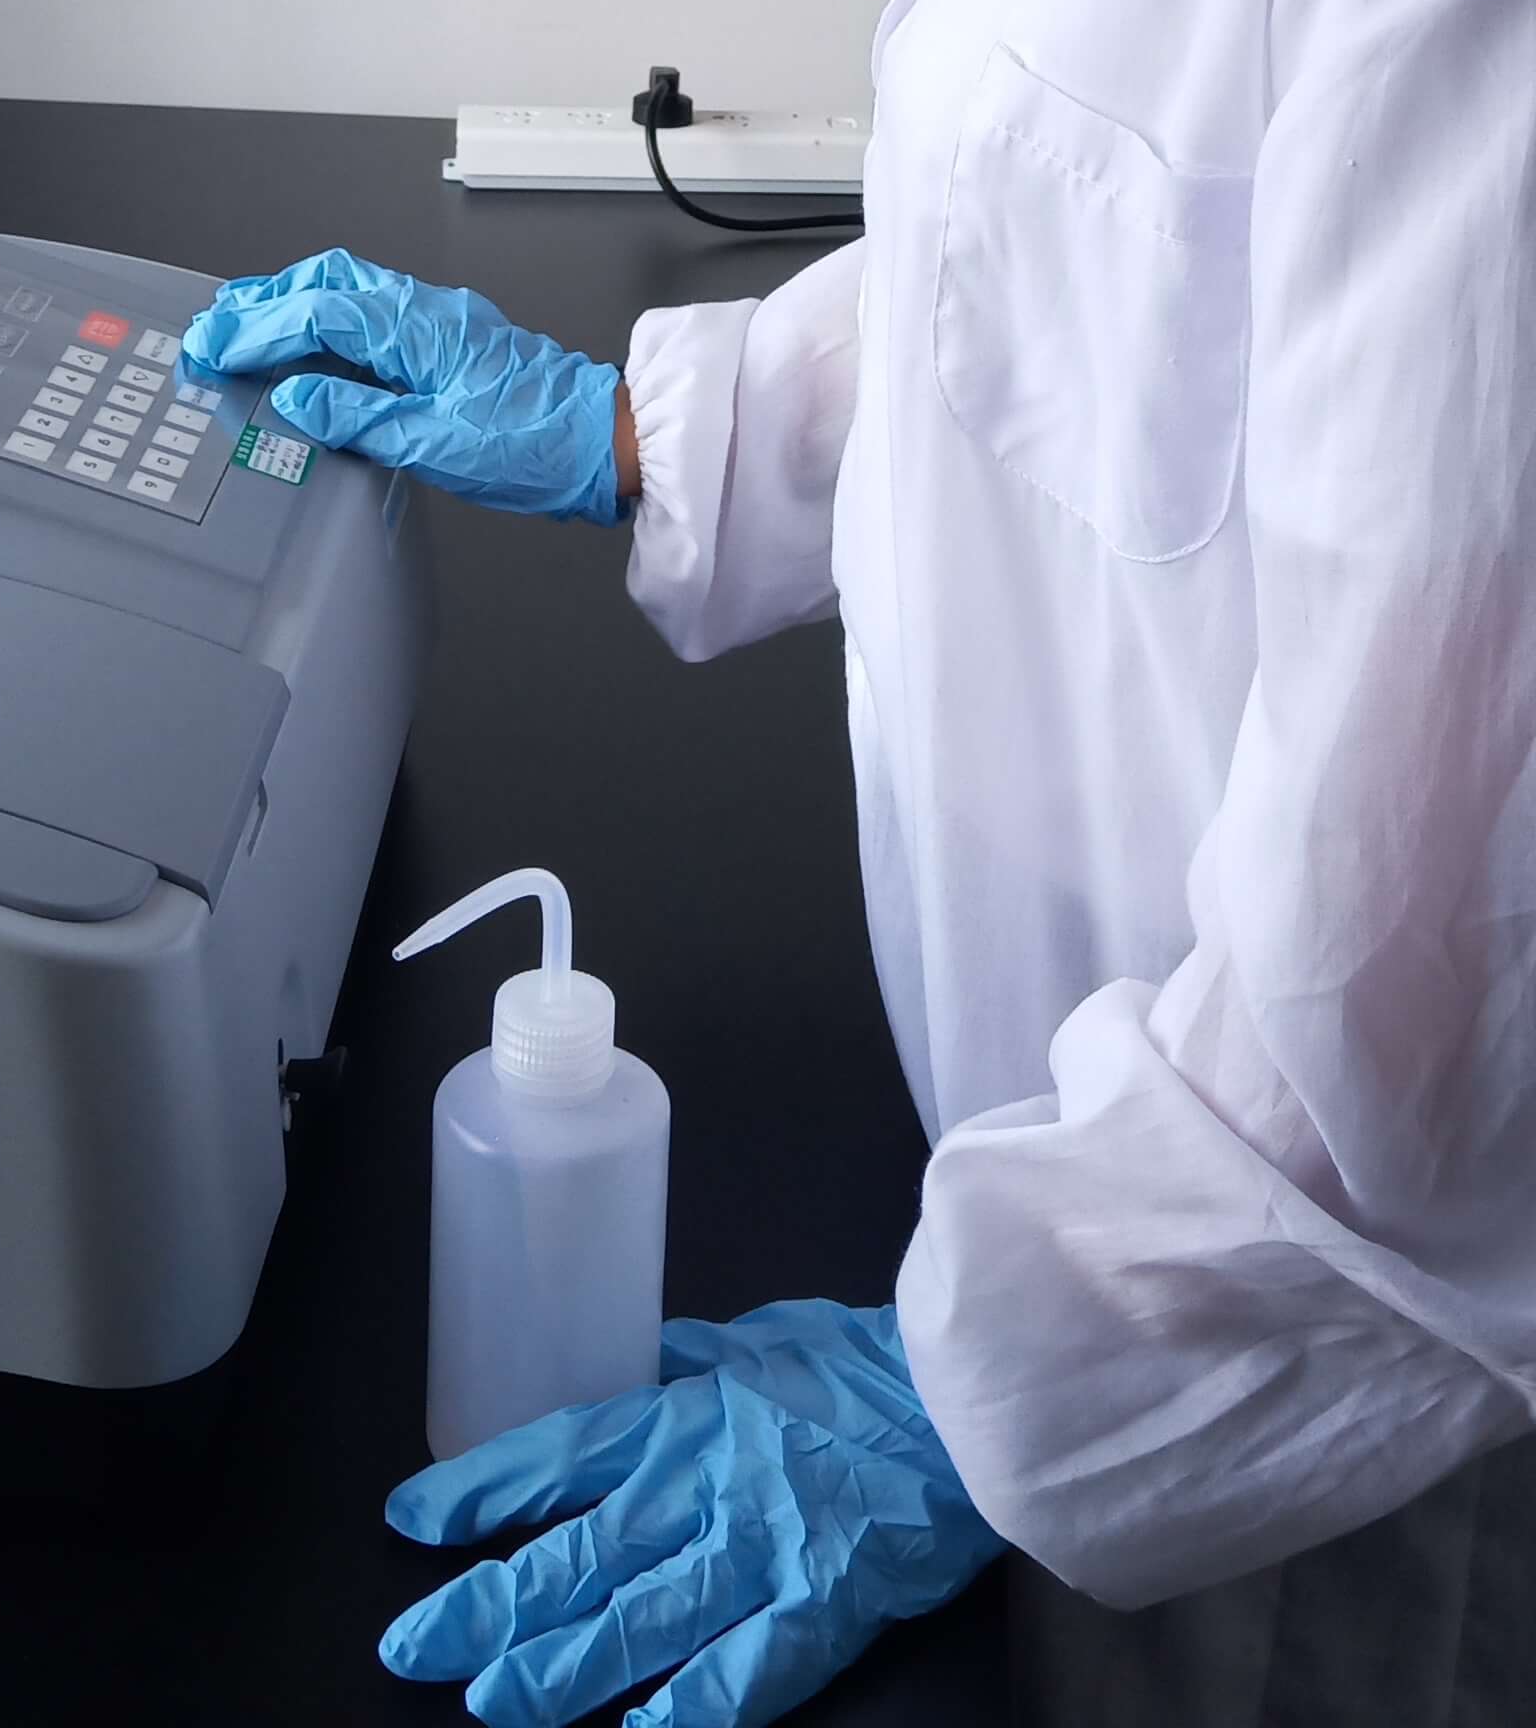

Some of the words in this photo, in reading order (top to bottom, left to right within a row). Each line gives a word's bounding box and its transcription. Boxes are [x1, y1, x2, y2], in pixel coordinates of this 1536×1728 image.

[37, 418, 52, 427] 2
[50, 396, 64, 404] 3
[65, 374, 79, 383] 4
[83, 460, 98, 469] 5
[97, 437, 112, 446] 6
[123, 393, 137, 402] 8
[144, 480, 158, 488] 9
[157, 456, 171, 466] 0
